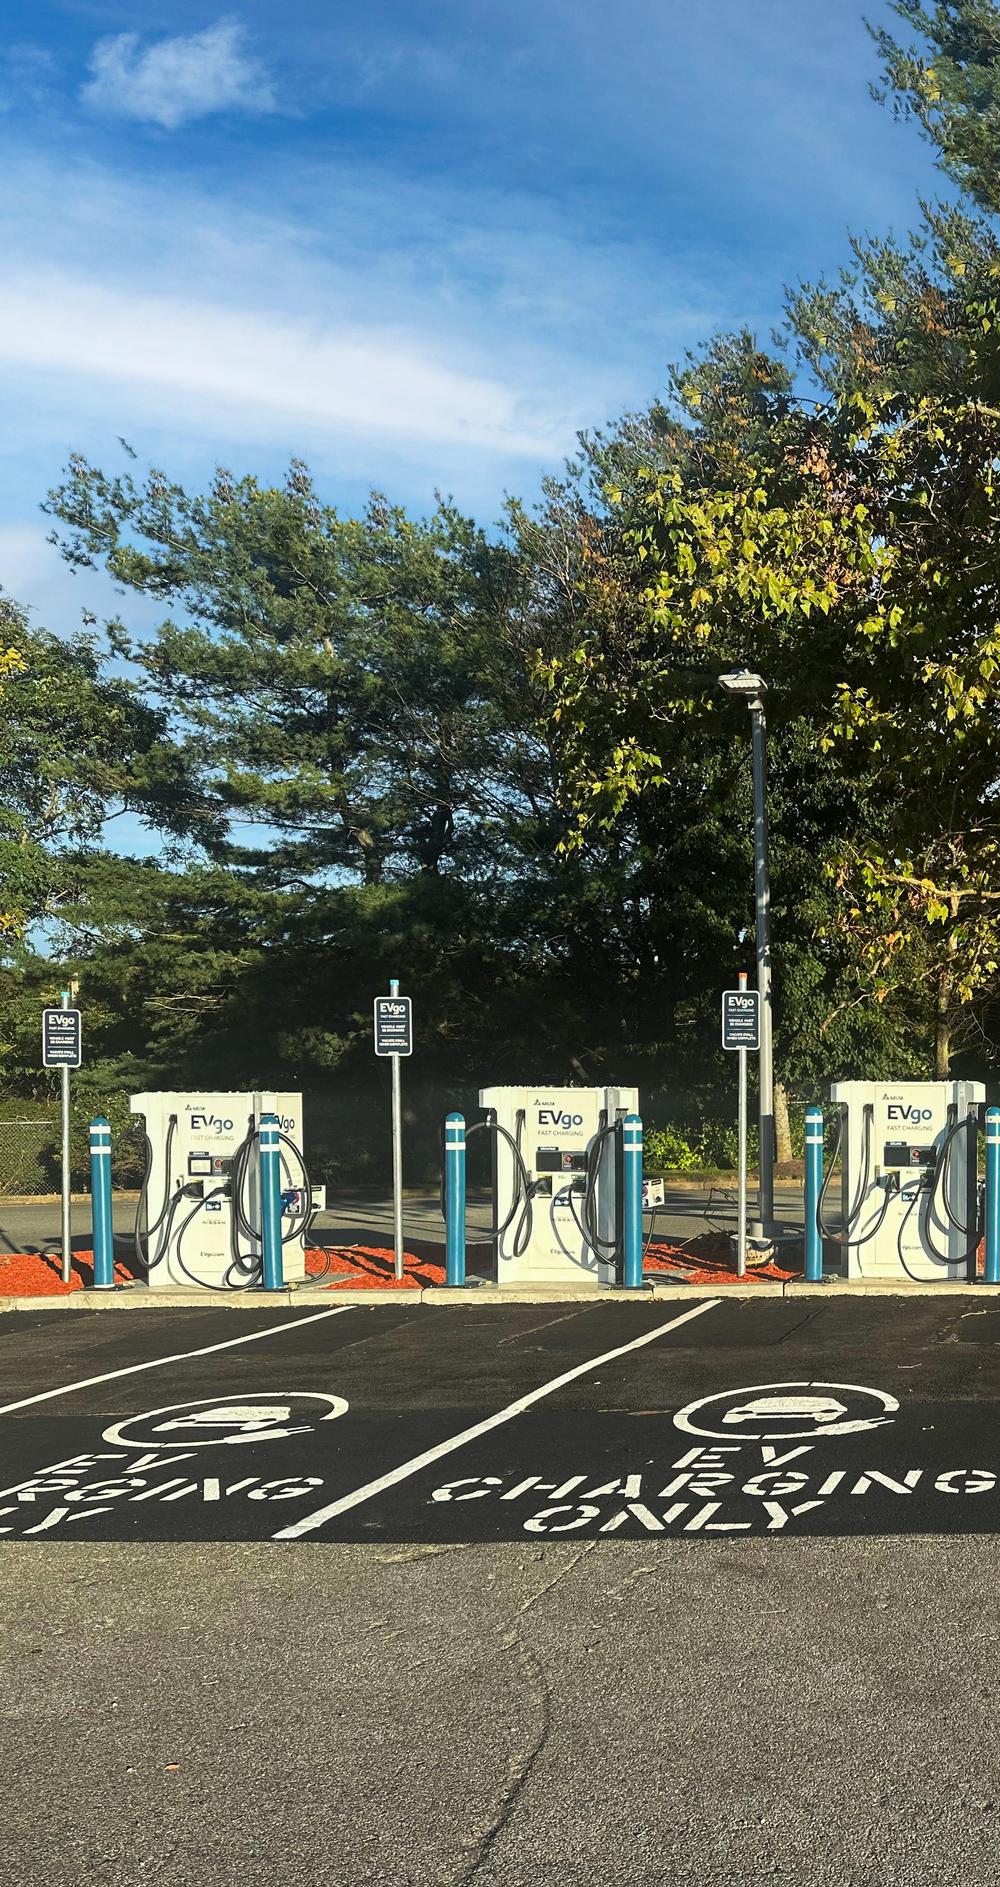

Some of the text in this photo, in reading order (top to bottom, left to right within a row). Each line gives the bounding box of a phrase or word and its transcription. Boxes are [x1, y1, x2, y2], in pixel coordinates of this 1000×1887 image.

[380, 1003, 406, 1015] EVgo
[728, 996, 755, 1008] EVgo
[48, 1015, 75, 1026] EVgo
[191, 1114, 233, 1134] EVgo
[275, 1114, 295, 1133] Vgo
[538, 1110, 583, 1129] EVgo
[887, 1104, 932, 1124] EVgo
[34, 1453, 199, 1475] EV
[672, 1446, 816, 1469] EV
[430, 1469, 998, 1502] CHARGING
[522, 1501, 826, 1532] ONLY
